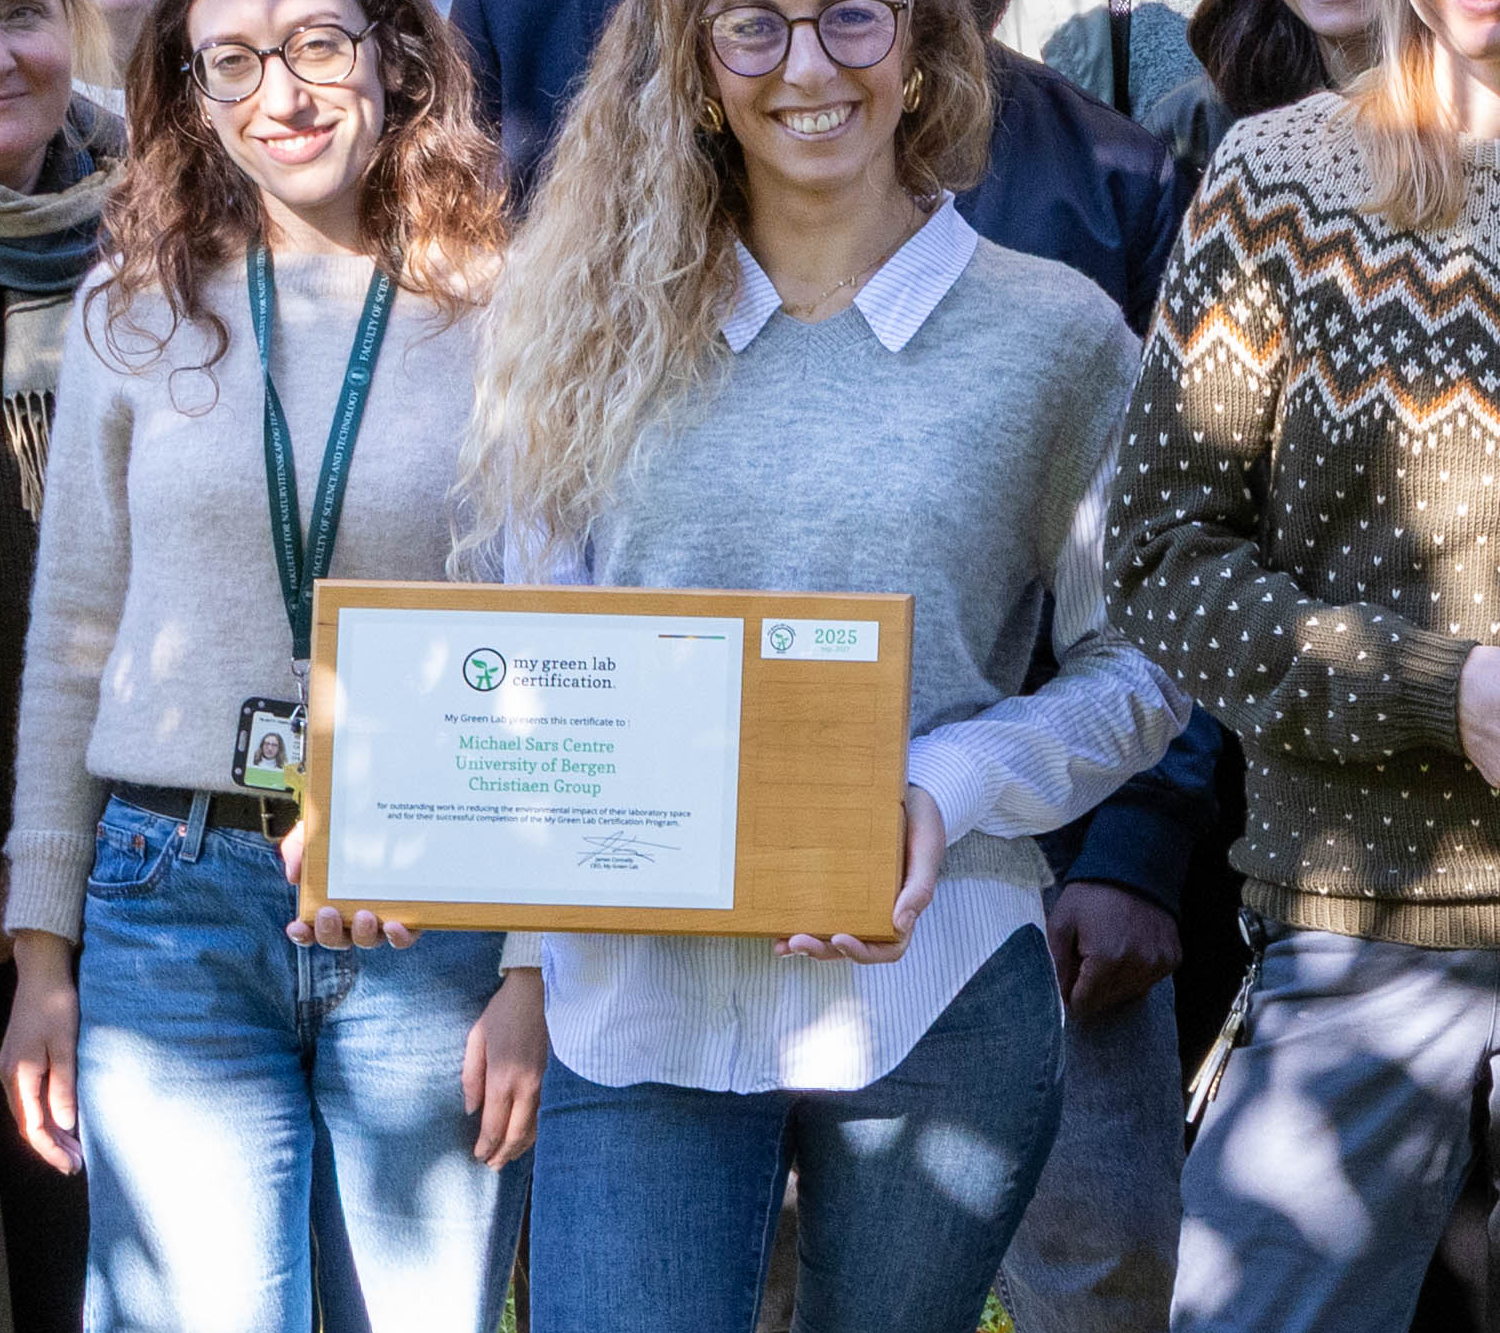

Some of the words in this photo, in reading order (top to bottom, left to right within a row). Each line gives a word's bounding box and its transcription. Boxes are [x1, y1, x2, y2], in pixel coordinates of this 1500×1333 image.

[375, 274, 390, 304] SCIEN
[371, 302, 383, 318] OF
[359, 317, 379, 362] FACULTY
[336, 389, 360, 451] TECHNOLOGY
[331, 452, 344, 473] AND
[322, 474, 339, 517] SCIENCE
[282, 523, 293, 541] FOR
[320, 518, 331, 532] OF
[312, 532, 327, 577] FACULTY
[814, 628, 858, 645] 2025
[513, 658, 541, 672] my
[542, 658, 587, 673] green
[592, 656, 617, 672] lab
[444, 714, 458, 724] My
[460, 714, 489, 723] Green
[491, 714, 507, 724] Lab
[550, 716, 567, 726] this
[569, 716, 614, 727] certificate
[459, 735, 521, 751] Michael
[525, 737, 559, 752] Sars
[562, 738, 615, 753] Centre
[455, 755, 538, 775] University
[541, 757, 558, 772] of
[561, 758, 617, 777] Bergen
[468, 776, 550, 793] Christiaen
[554, 778, 602, 797] Group
[377, 802, 388, 810] for
[389, 802, 435, 812] outstanding
[436, 803, 455, 811] work
[466, 804, 499, 814] reducing
[501, 805, 513, 813] the
[515, 805, 570, 815] environmental
[572, 807, 598, 817] impact
[609, 808, 627, 816] their
[628, 809, 669, 818] laboratory
[669, 811, 692, 819] space
[387, 812, 402, 820] and
[403, 812, 414, 820] for
[436, 813, 475, 821] successful
[476, 814, 519, 823] completion
[530, 815, 543, 823] the
[544, 816, 555, 825] My
[557, 816, 581, 824] Green
[582, 816, 596, 825] Lab
[598, 817, 644, 826] Certification
